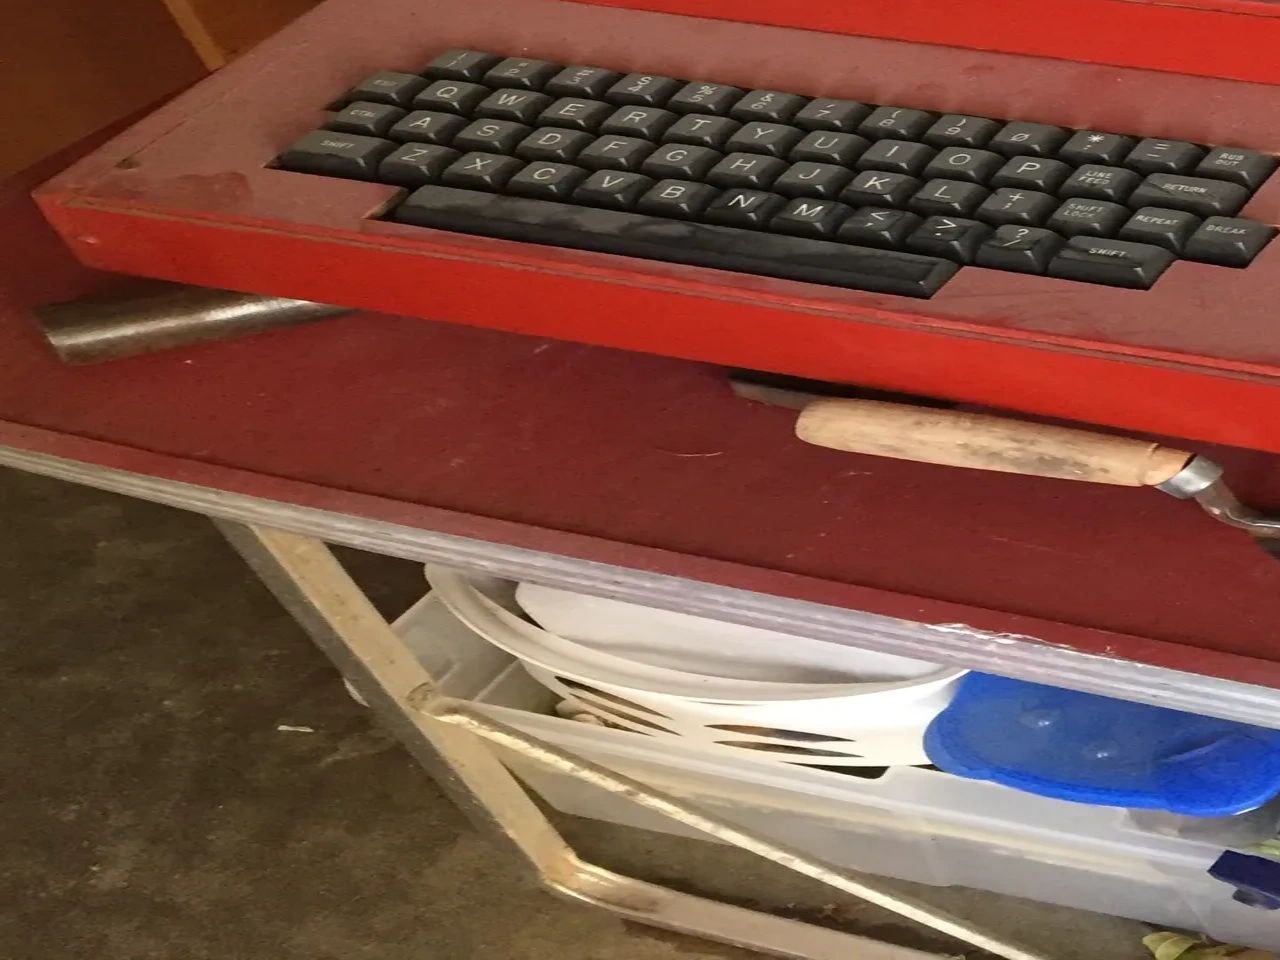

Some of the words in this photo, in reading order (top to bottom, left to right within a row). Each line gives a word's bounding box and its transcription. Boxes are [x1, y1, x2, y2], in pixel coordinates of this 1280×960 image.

[436, 86, 458, 98] Q
[497, 93, 528, 106] W
[558, 103, 585, 117] E
[408, 116, 431, 129] A
[622, 111, 648, 123] R
[476, 124, 500, 137] S
[691, 119, 712, 131] T
[537, 133, 562, 145] D
[754, 127, 775, 140] Y
[601, 140, 628, 152] F
[813, 136, 840, 149] U
[401, 148, 430, 162] Z
[665, 149, 688, 162] G
[884, 145, 900, 158] I
[1218, 152, 1244, 161] RUB
[463, 157, 493, 171] X
[729, 158, 757, 170] H
[948, 153, 971, 166] O
[1215, 159, 1240, 167] OUT
[532, 167, 556, 180] C
[798, 167, 822, 180] J
[1016, 162, 1041, 173] P
[1078, 176, 1111, 185] FEED
[1085, 170, 1113, 179] LINE
[601, 175, 625, 188] V
[863, 176, 891, 190] K
[1161, 183, 1208, 193] RETURN
[659, 185, 687, 199] B
[934, 185, 952, 199] L
[728, 194, 755, 208] N
[792, 203, 825, 217] M
[1063, 210, 1095, 218] LOCK
[1067, 203, 1104, 213] SHIFT
[1135, 214, 1180, 225] REPEAT
[1205, 224, 1247, 234] BREAK
[1088, 247, 1128, 258] SHIFT
